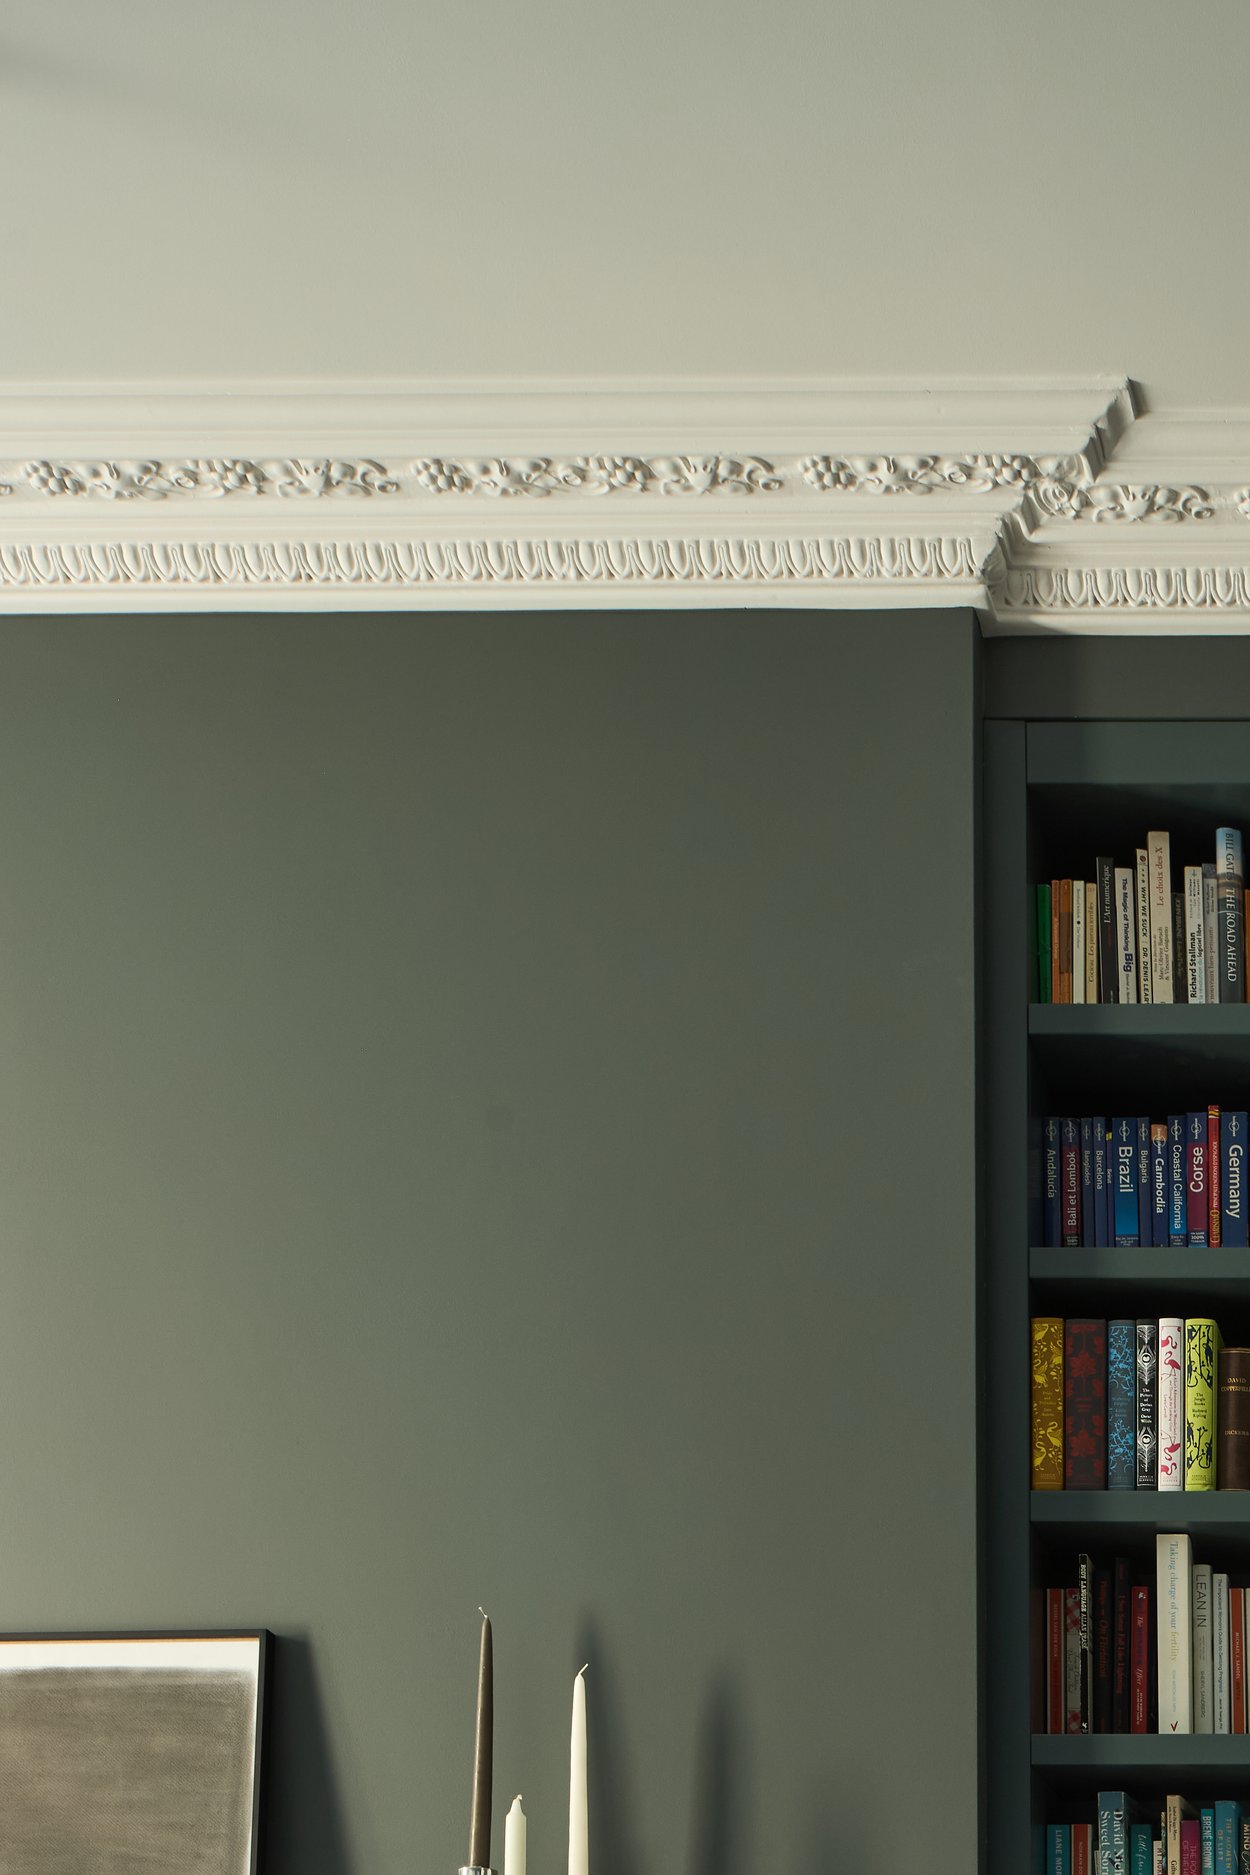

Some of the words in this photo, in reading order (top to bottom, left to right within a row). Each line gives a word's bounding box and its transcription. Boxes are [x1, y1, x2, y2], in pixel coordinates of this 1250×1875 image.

[1225, 833, 1234, 851] BILL
[1226, 853, 1234, 880] GATES
[1141, 905, 1147, 917] WE
[1226, 888, 1236, 909] THE
[1122, 923, 1130, 951] Thinking
[1227, 913, 1236, 942] ROAD
[1123, 953, 1133, 972] Big
[1228, 945, 1237, 981] AHEAD
[1047, 1149, 1057, 1198] Andalucía
[1067, 1152, 1076, 1192] Lombok
[1118, 1146, 1133, 1193] Brazil
[1173, 1144, 1182, 1180] Coastal
[1190, 1147, 1204, 1192] Corse
[1155, 1158, 1165, 1214] Cambodia
[1226, 1144, 1243, 1218] Germany
[1068, 1208, 1076, 1225] Bali
[1069, 1195, 1076, 1204] et
[1174, 1183, 1182, 1229] California
[1196, 1574, 1206, 1610] LEAN
[1196, 1614, 1207, 1628] IN
[1101, 1811, 1110, 1847] Sweet
[1114, 1811, 1123, 1845] David
